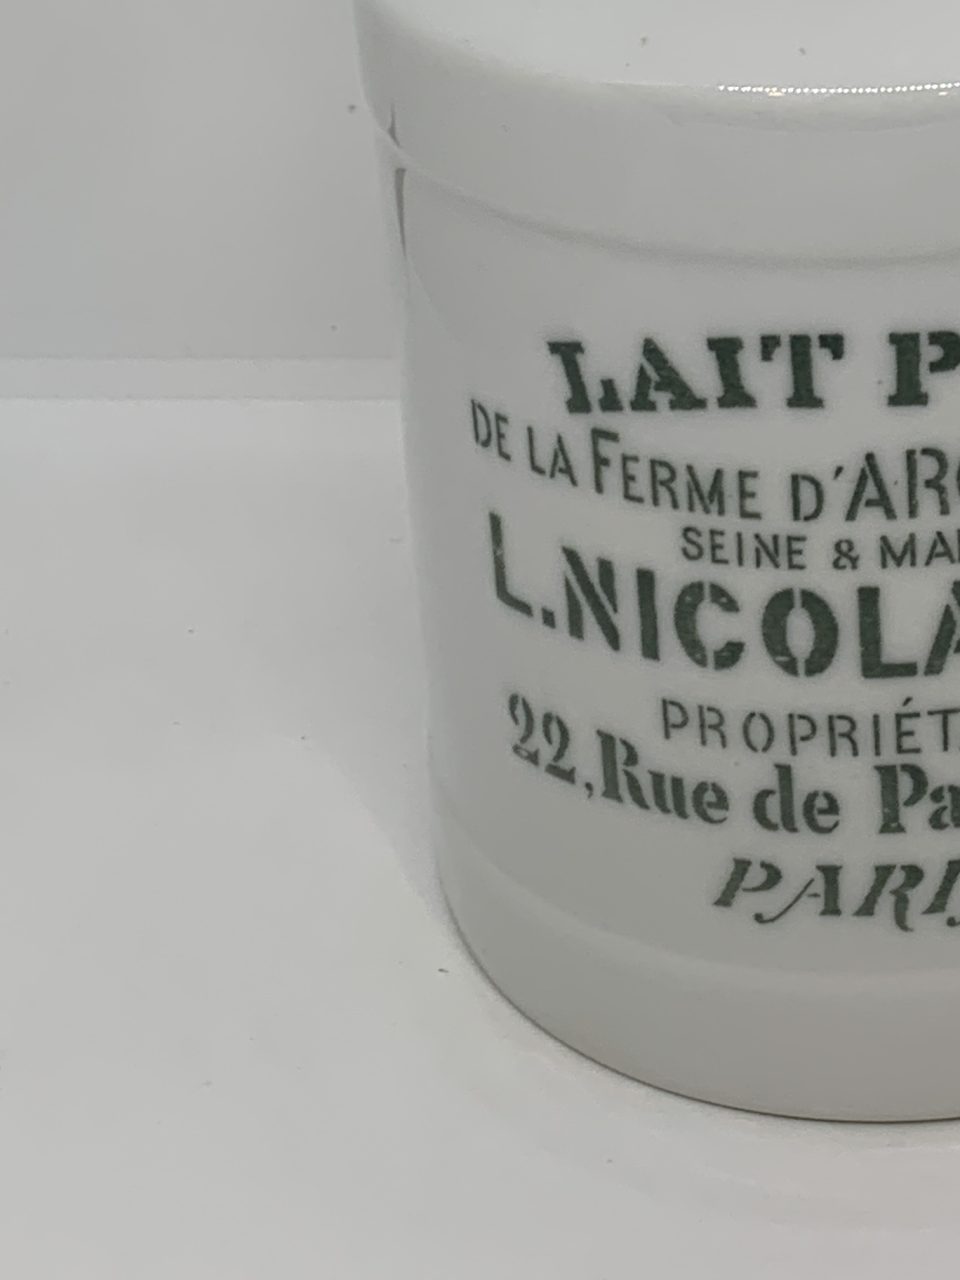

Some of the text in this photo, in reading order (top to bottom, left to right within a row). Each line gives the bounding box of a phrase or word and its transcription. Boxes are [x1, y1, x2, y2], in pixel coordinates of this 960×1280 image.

[546, 332, 844, 414] LAIT
[470, 398, 511, 462] DE
[527, 426, 578, 487] LA
[590, 427, 762, 520] FERME
[680, 526, 807, 570] SEINE
[832, 538, 860, 570] &
[752, 764, 840, 834] de
